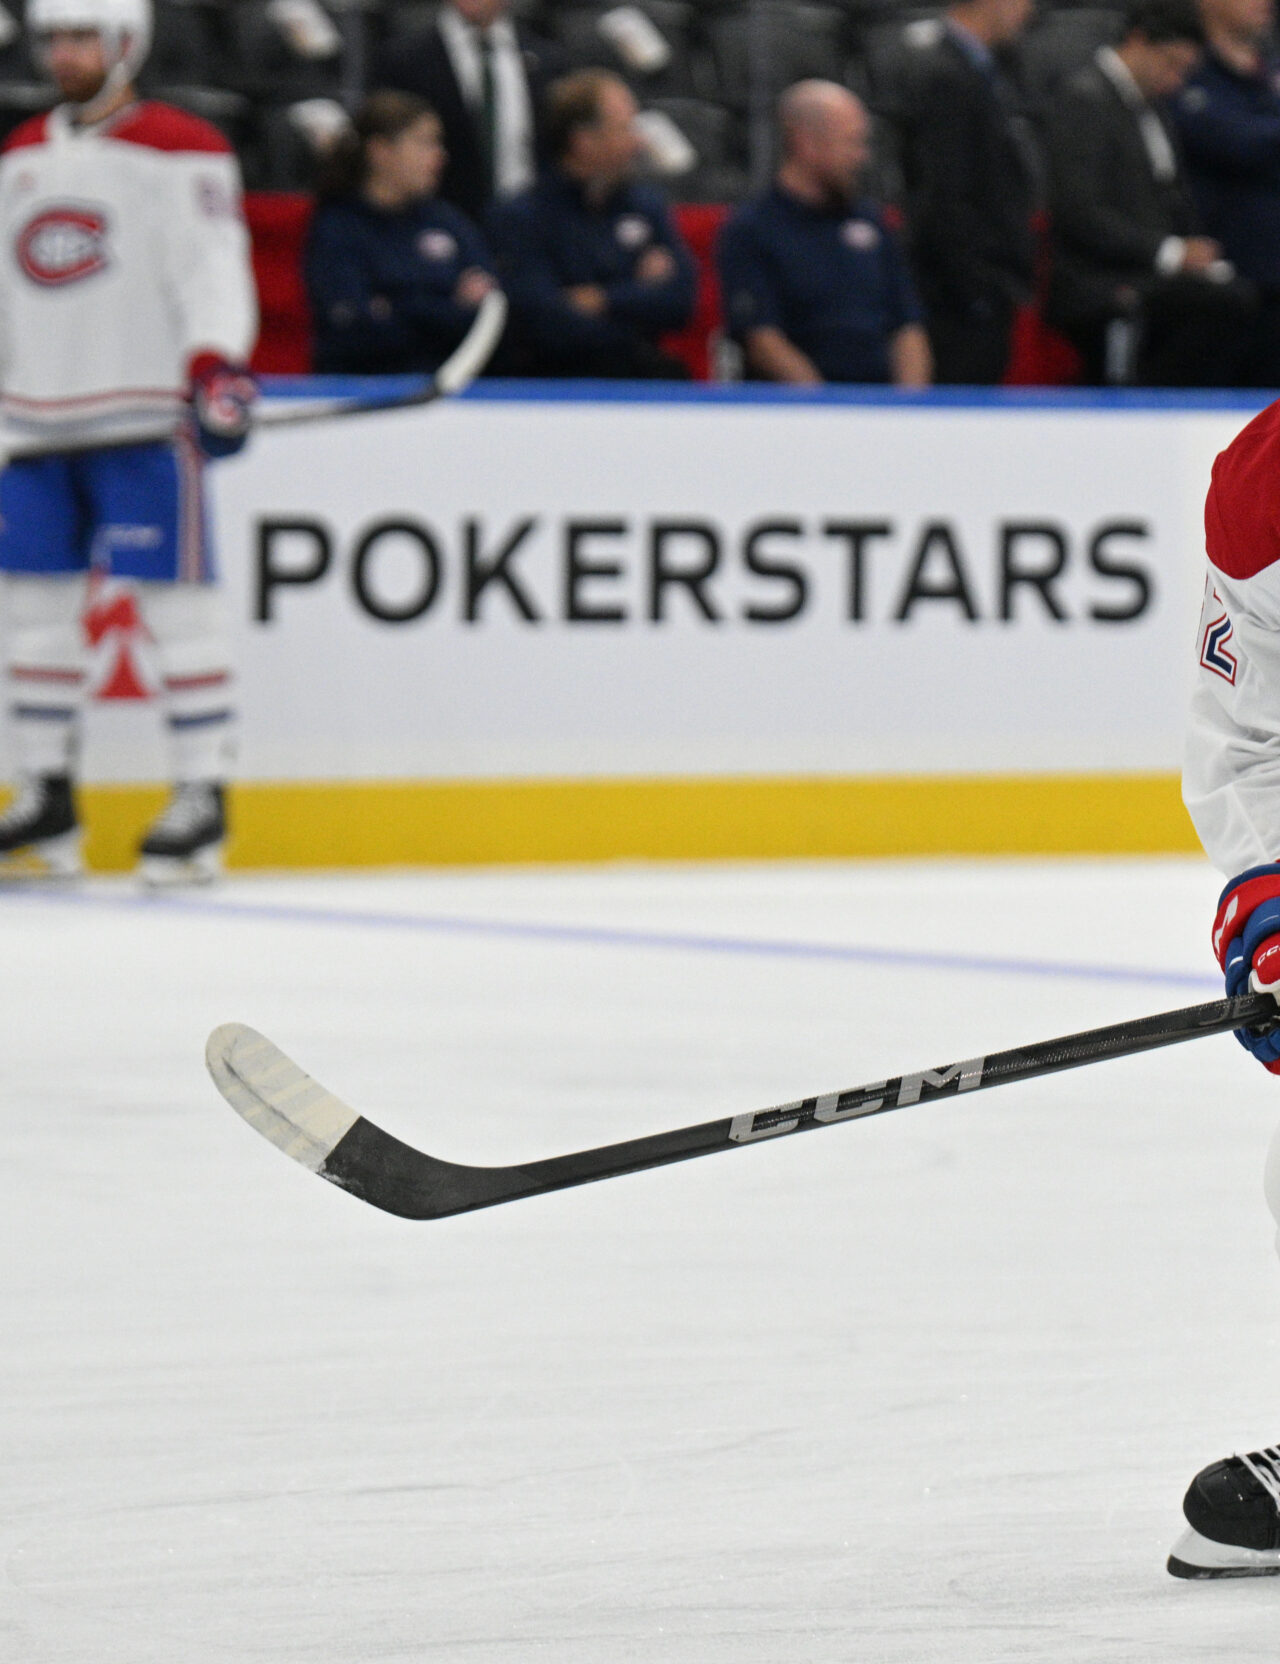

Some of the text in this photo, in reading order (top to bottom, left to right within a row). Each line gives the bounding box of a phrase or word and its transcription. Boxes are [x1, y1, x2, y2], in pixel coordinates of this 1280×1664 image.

[253, 515, 1156, 625] POKERSTARS
[1199, 580, 1238, 687] 2
[728, 1056, 986, 1143] CCM
